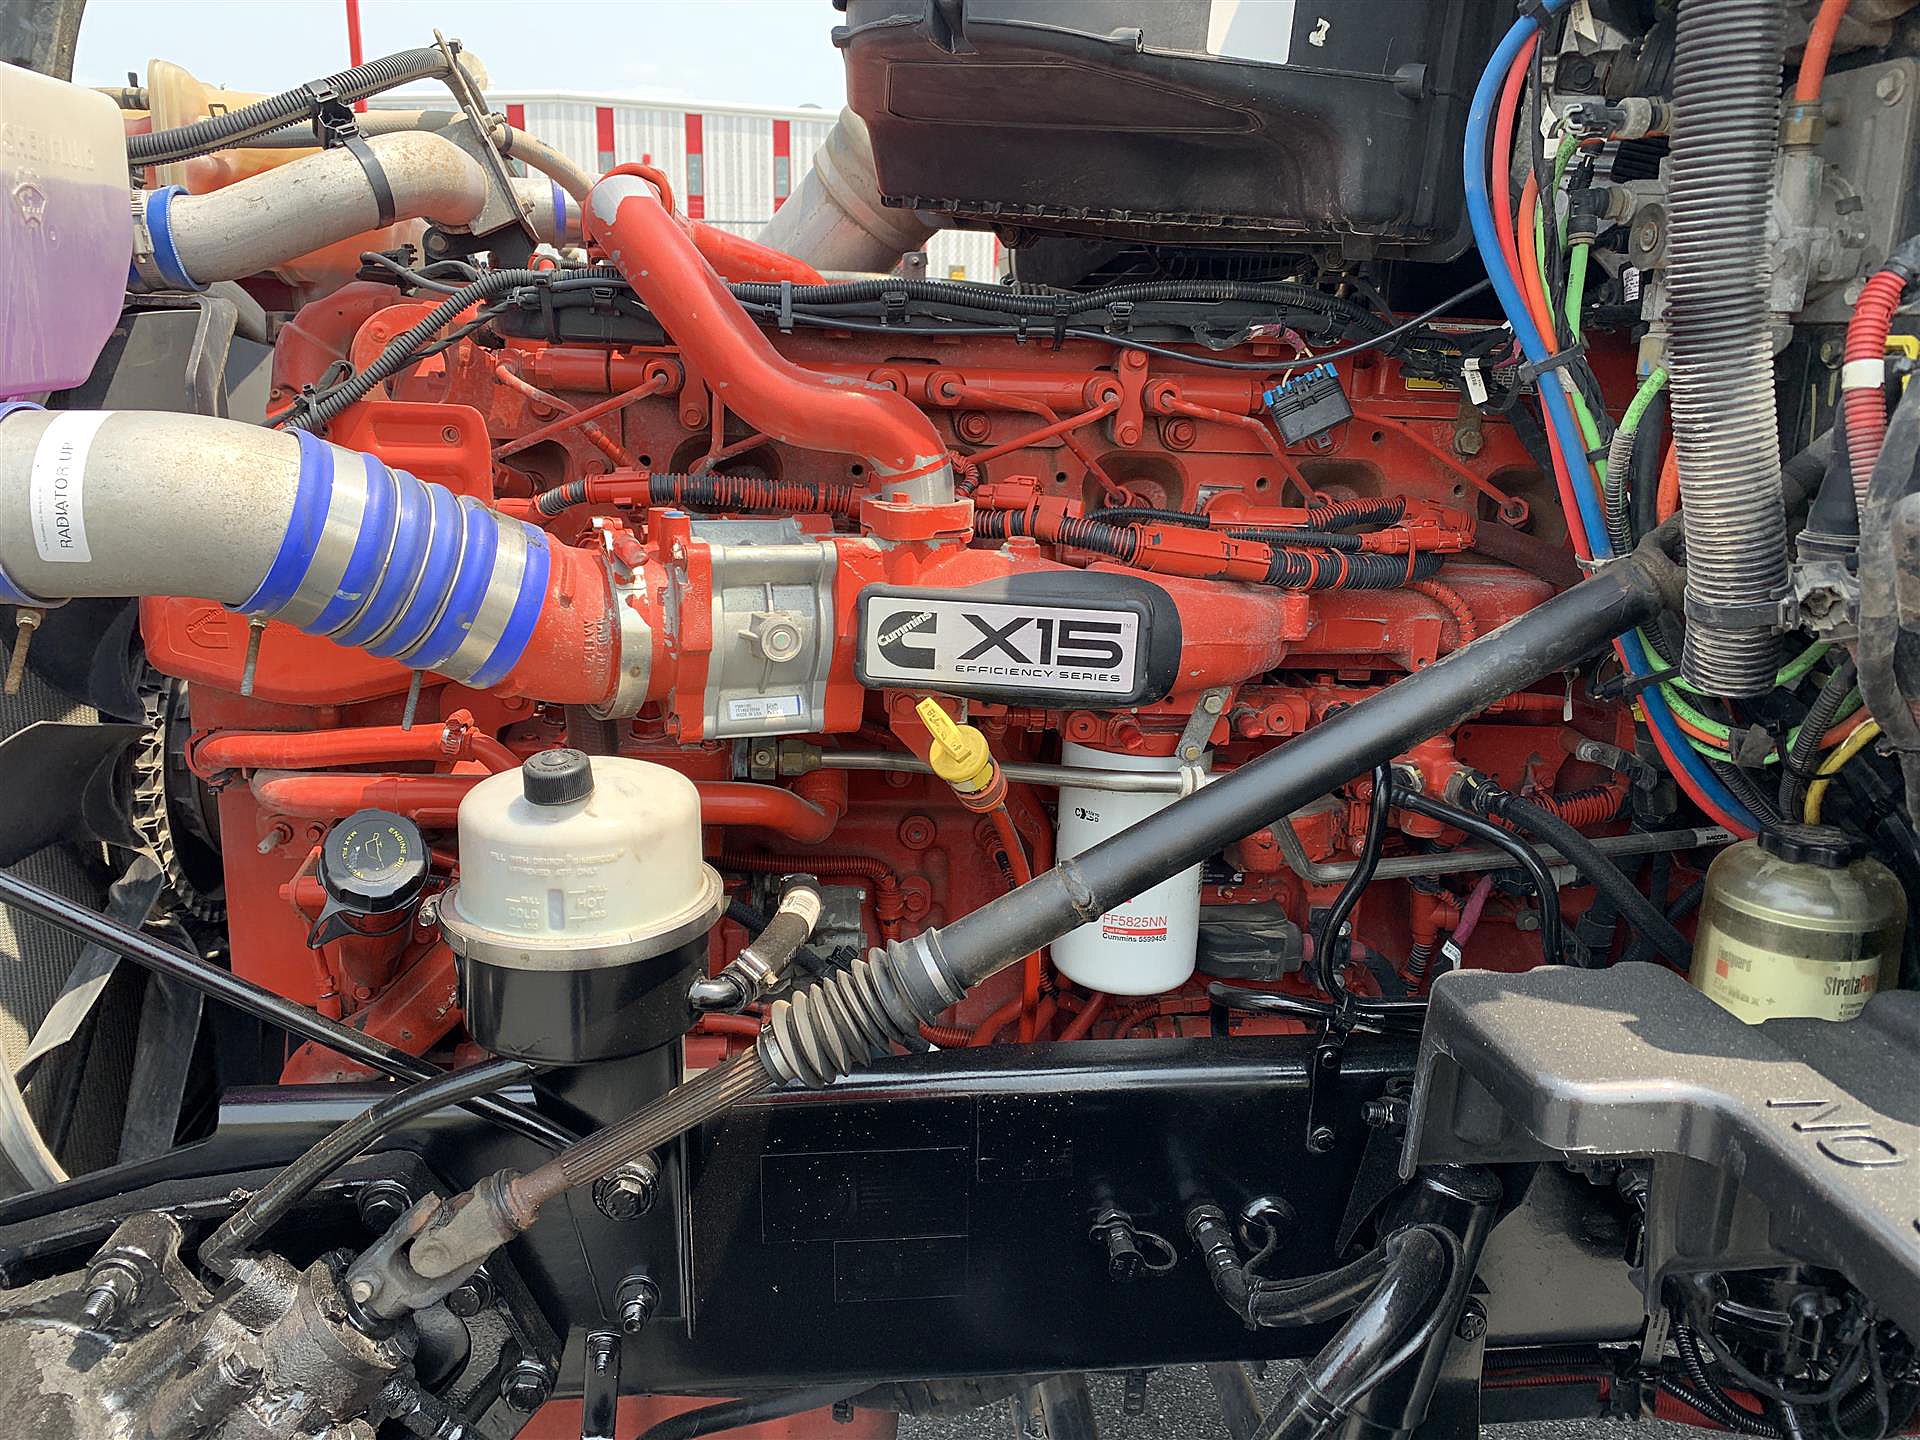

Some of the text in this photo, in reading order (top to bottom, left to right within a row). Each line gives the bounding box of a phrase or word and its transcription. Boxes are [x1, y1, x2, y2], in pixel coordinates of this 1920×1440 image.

[54, 466, 73, 548] RADIATOR
[878, 610, 934, 647] Cummins
[956, 613, 1124, 670] X15
[955, 664, 1121, 682] EFFICIENCY SERIES
[343, 830, 359, 847] MAX
[387, 827, 407, 871] ENGINE OIL
[1103, 913, 1168, 928] FF5825NN
[1102, 932, 1137, 942] Cummins
